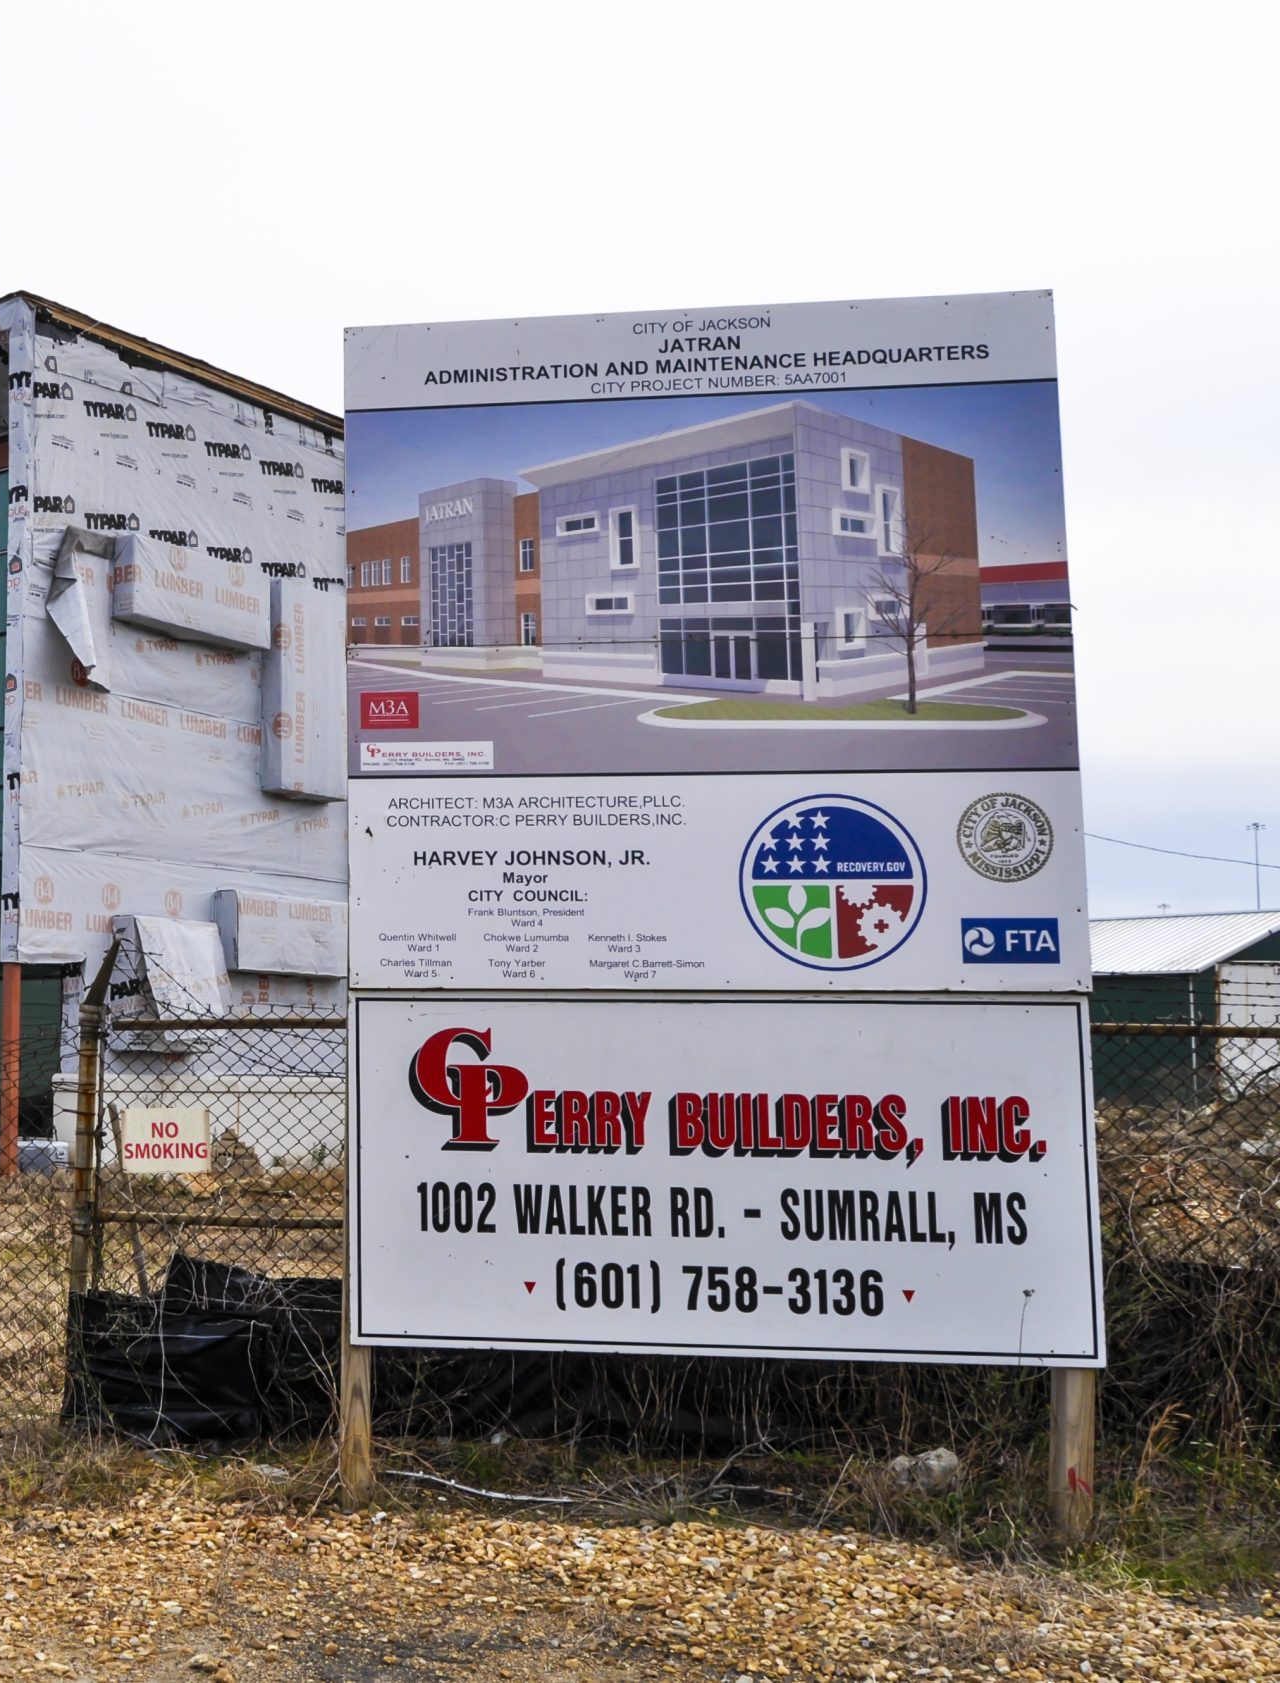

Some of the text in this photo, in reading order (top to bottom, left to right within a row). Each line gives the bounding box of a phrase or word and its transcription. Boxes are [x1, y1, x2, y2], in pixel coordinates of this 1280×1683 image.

[632, 317, 771, 335] CITY OF JACKSON
[659, 336, 741, 354] JATRAN
[424, 344, 990, 386] ADMINISTRATION AND MAINTENANCE HEADQUARTERS
[590, 372, 847, 395] CITY PROJECT NUMBER: 5AA7001
[83, 401, 125, 420] TYPAR
[146, 422, 185, 441] TYPAR
[204, 441, 241, 459] TYPAR
[259, 461, 294, 477] TYPAR
[311, 478, 345, 494] TYPAR
[425, 496, 474, 528] JATRAN
[84, 513, 127, 530] TYPAR
[261, 562, 296, 578] TYPAR
[155, 569, 204, 600] LUMBER
[215, 587, 260, 615] LUMBER
[55, 686, 108, 714] LUMBER
[369, 699, 409, 715] M3A
[120, 700, 169, 727] LUMBER
[180, 713, 227, 739] LUMBER
[388, 797, 479, 810] ARCHITECT:
[482, 796, 514, 809] M3A
[515, 814, 568, 827] PERRY
[962, 798, 1049, 838] CITY OF JACKSON
[413, 850, 651, 868] HARVEY JOHNSON, JR.
[968, 848, 1046, 878] MISSISSIPPI
[837, 862, 906, 873] RECOVERY.GOV
[502, 871, 548, 887] Mayor
[468, 889, 588, 902] CITY COUNCIL:
[288, 902, 331, 923] LUMBER
[468, 908, 585, 917] Frank Bluntson, President
[511, 919, 543, 927] Ward 4
[378, 933, 457, 942] Quentin Whitwell
[483, 933, 569, 942] Chokwe Lumumba
[588, 933, 625, 942] Kenneth
[636, 933, 667, 942] Stokes
[1005, 930, 1056, 952] FTA
[408, 944, 432, 952] Ward
[505, 944, 539, 953] Ward 2
[608, 944, 641, 953] Ward 3
[380, 958, 452, 967] Charles Tillman
[488, 959, 546, 969] Tony Yarber
[589, 959, 630, 970] Margaret
[404, 969, 438, 978] Ward 5
[502, 970, 536, 978] Ward 6
[624, 970, 657, 979] Ward 7
[151, 1122, 179, 1138] NO
[669, 1092, 923, 1169] BUILDERS,
[941, 1096, 1047, 1163] INC.
[124, 1143, 208, 1159] SMOKING
[417, 1181, 496, 1233] 1002
[513, 1184, 652, 1237] WALKER
[670, 1186, 725, 1238] RD.
[780, 1188, 955, 1251] SUMRALL,
[973, 1192, 1028, 1245] MS
[556, 1257, 884, 1317] (601) 758-3136
